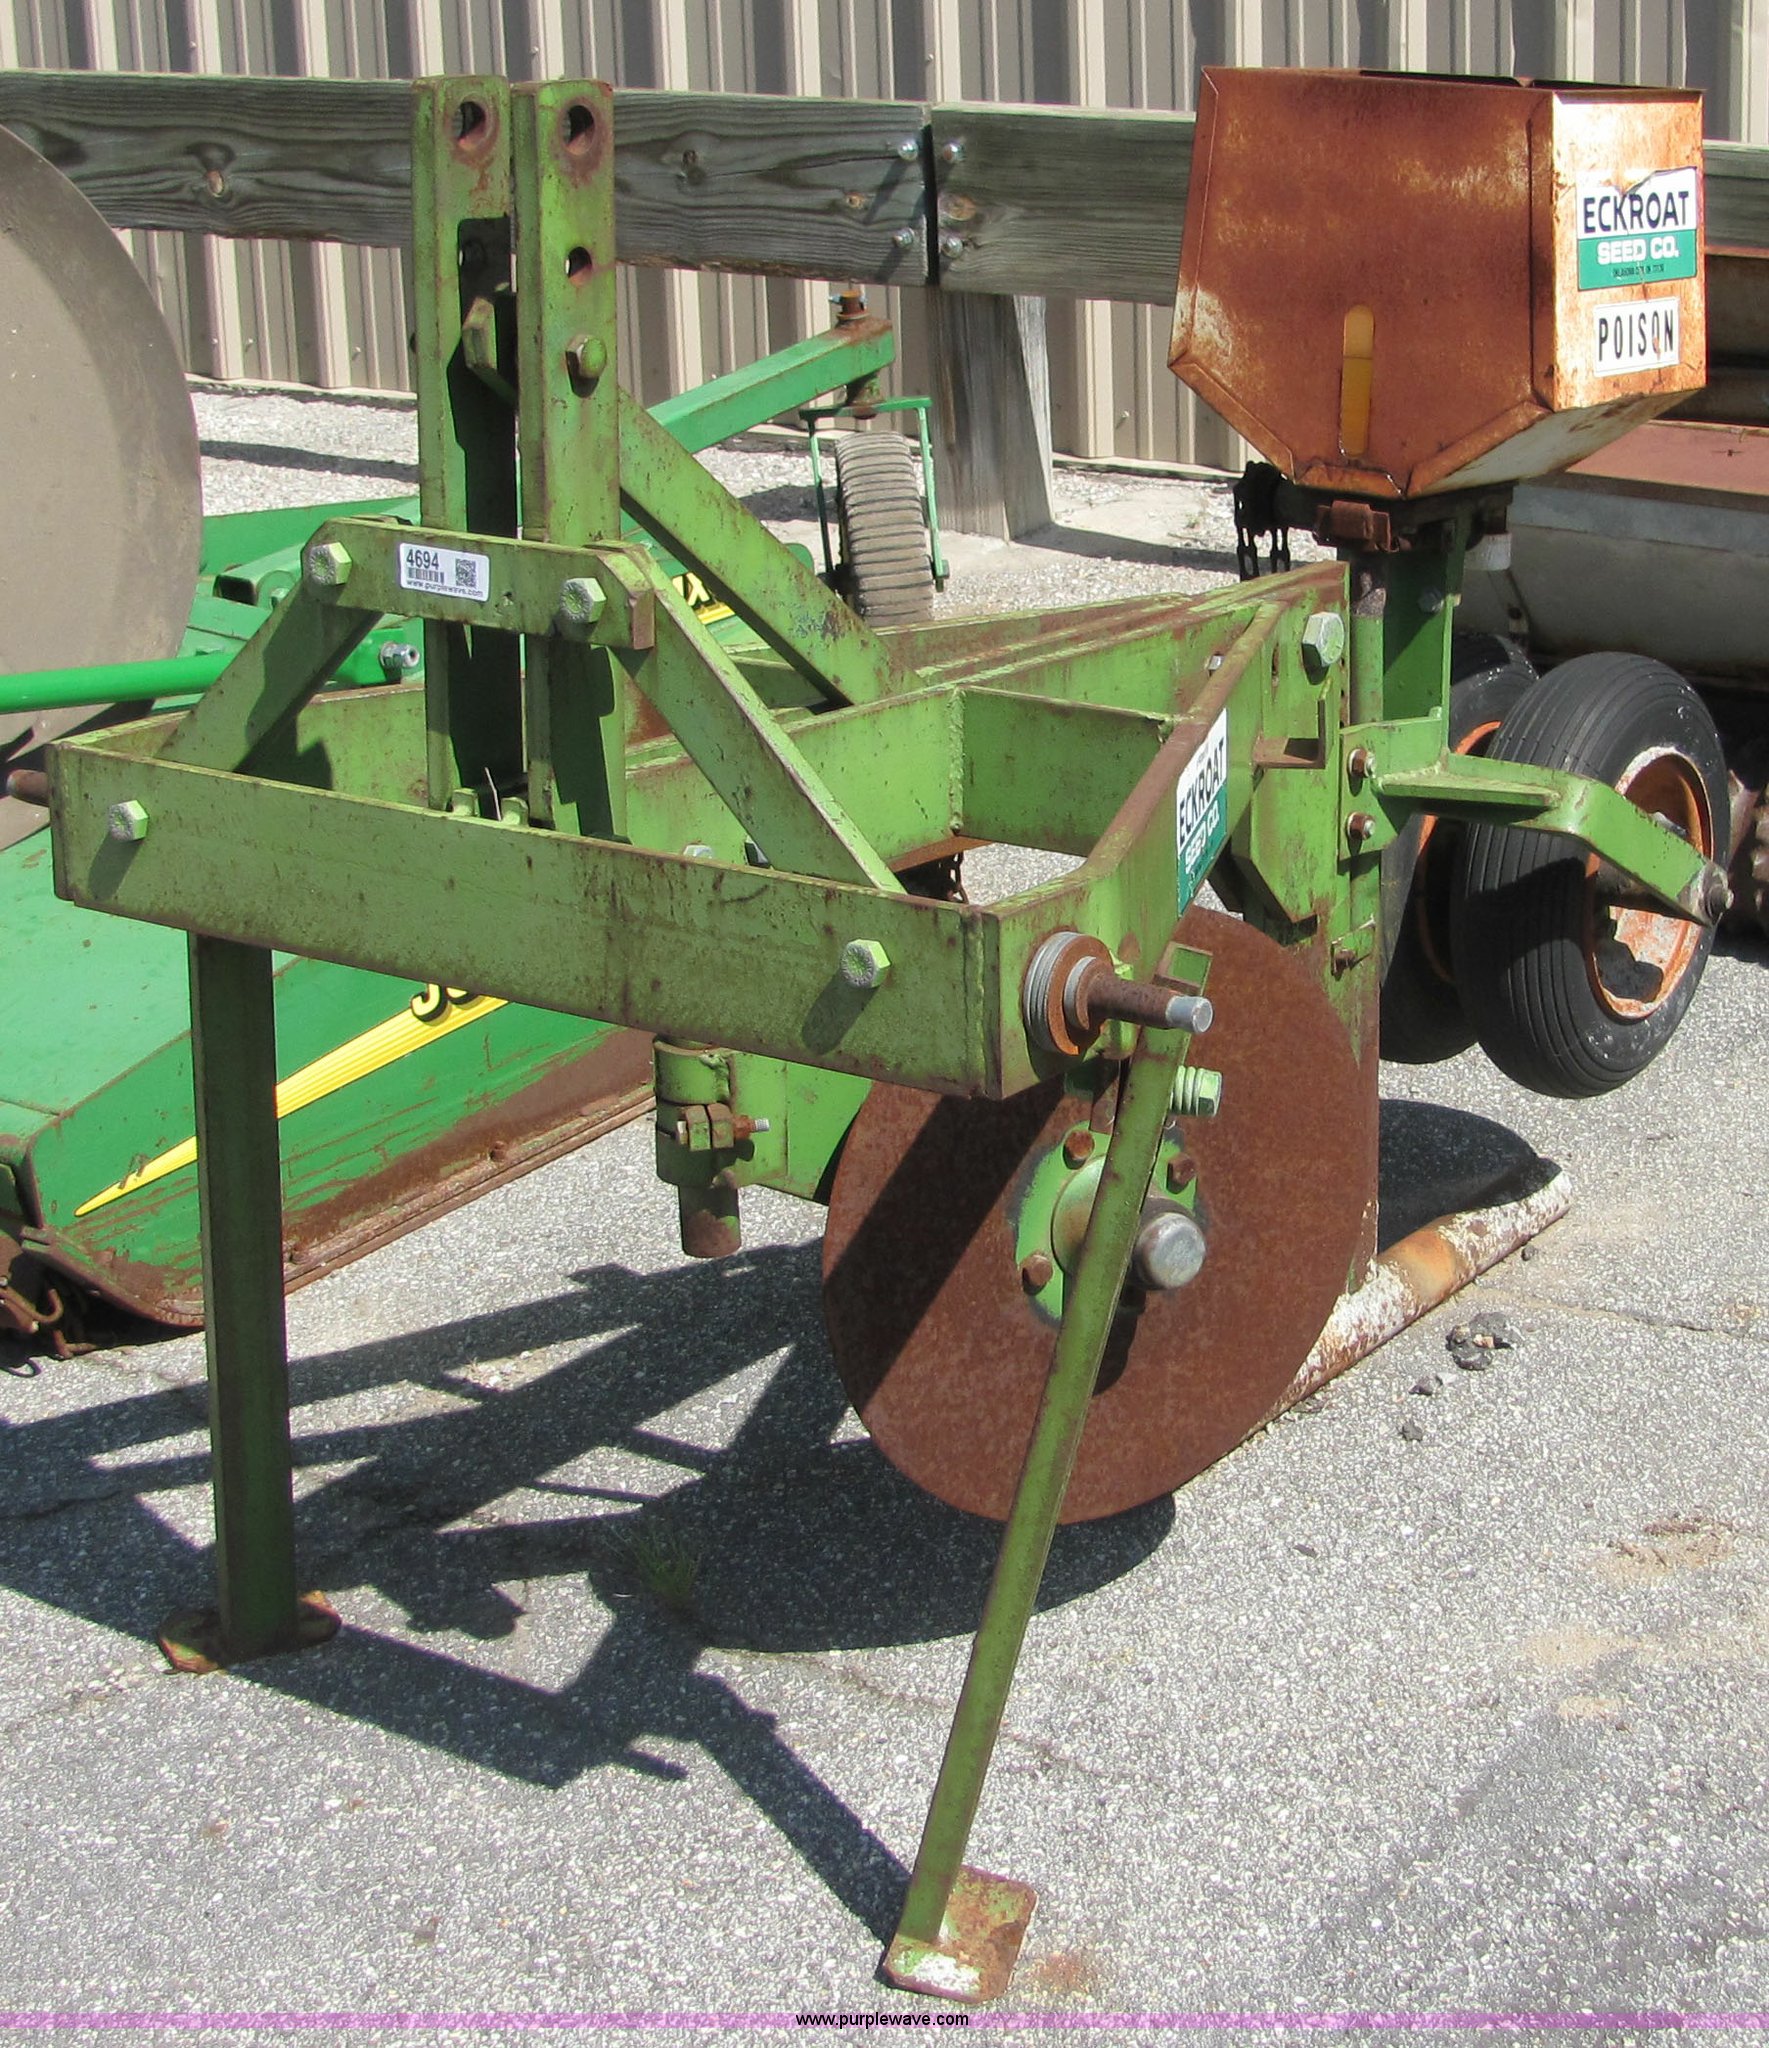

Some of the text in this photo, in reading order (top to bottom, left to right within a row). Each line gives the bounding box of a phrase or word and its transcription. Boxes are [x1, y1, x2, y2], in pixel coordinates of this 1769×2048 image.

[1583, 190, 1689, 234] ECKROAT
[1597, 235, 1679, 265] SEED CO.
[1598, 309, 1674, 361] POISON
[406, 548, 440, 570] 4694
[406, 580, 484, 598] www.purplewave.com
[1179, 736, 1225, 848] ECKROAT
[1185, 820, 1207, 875] SEED
